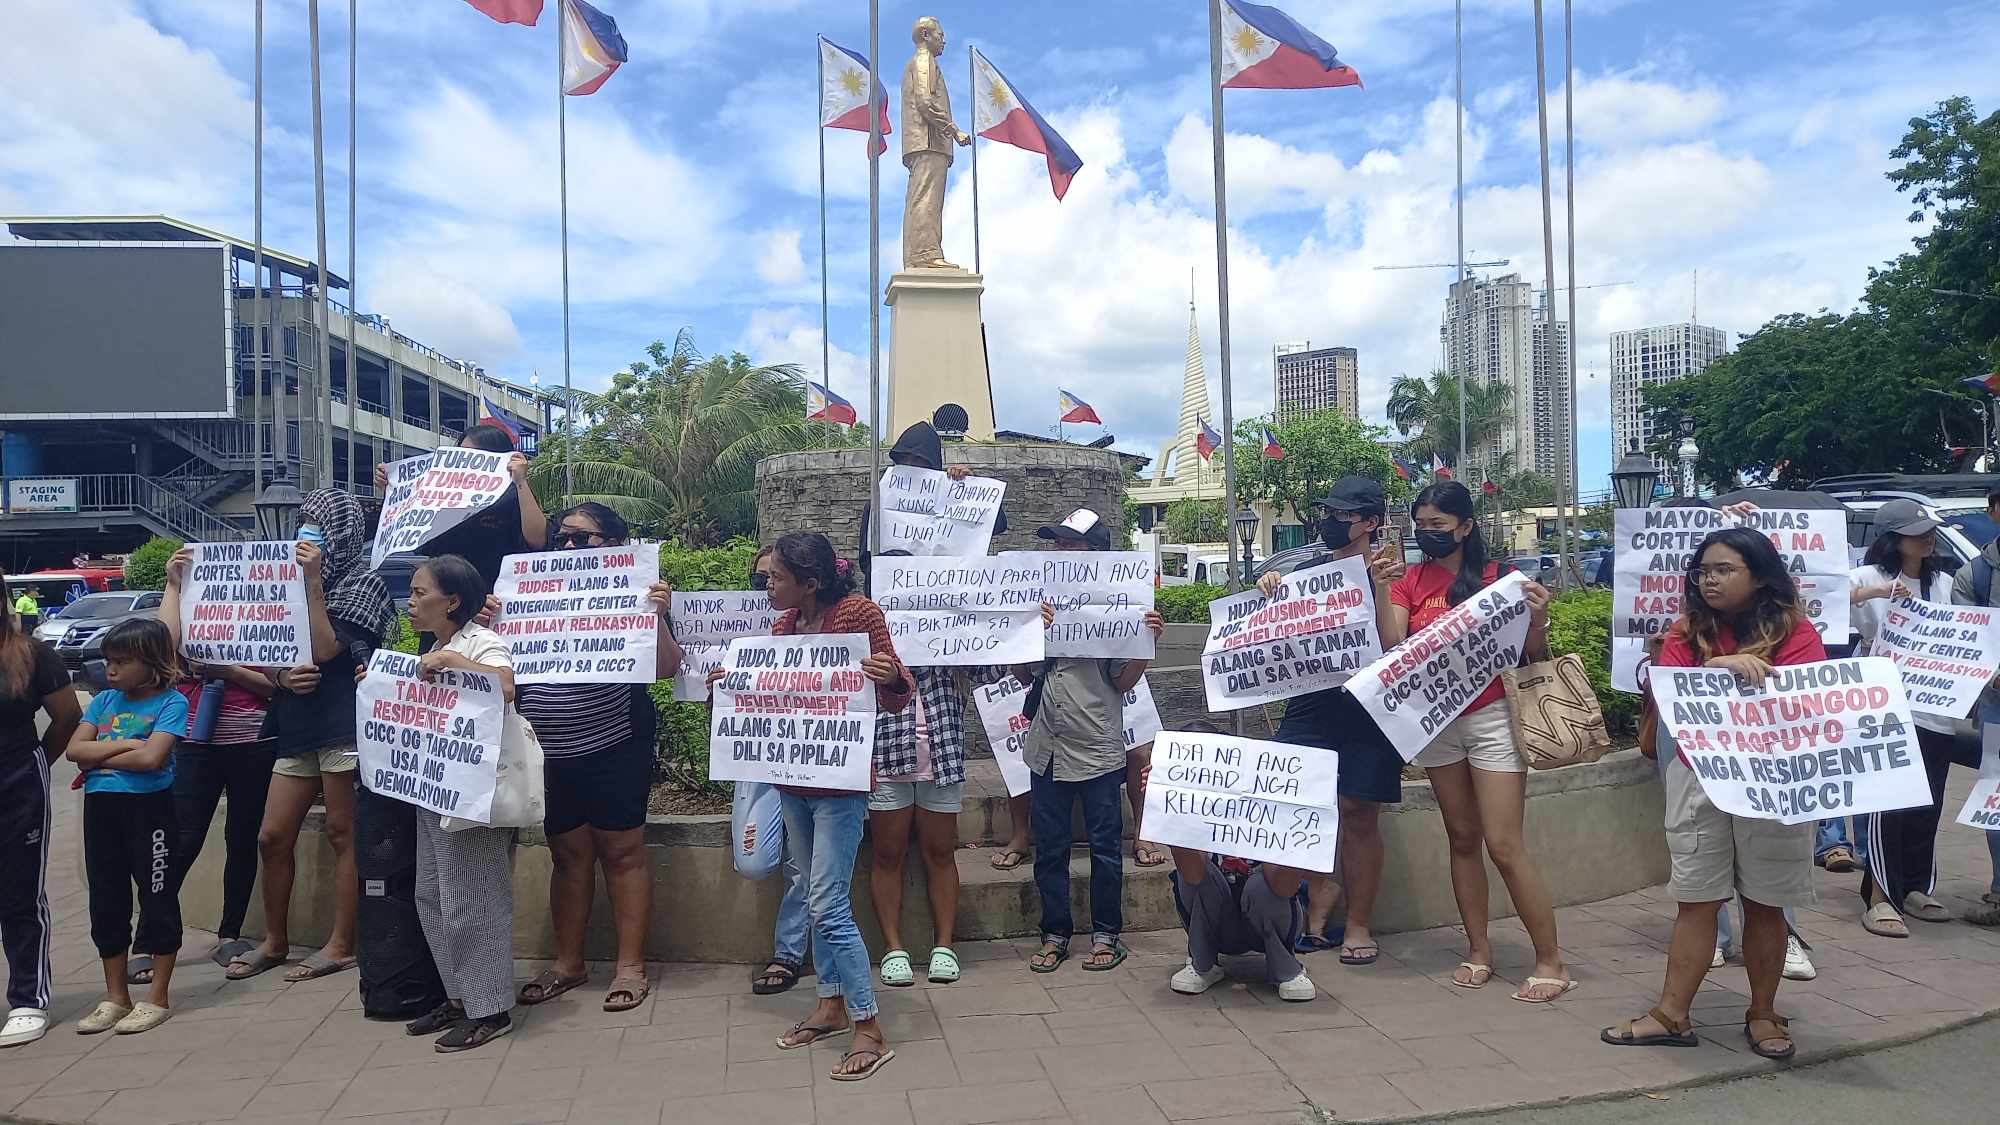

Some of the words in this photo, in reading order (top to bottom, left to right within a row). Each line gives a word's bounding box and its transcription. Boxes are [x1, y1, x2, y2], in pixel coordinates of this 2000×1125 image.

[920, 479, 937, 495] MI
[898, 498, 935, 513] KUNG
[1645, 510, 1723, 529] MAYOR
[1631, 531, 1711, 550] CORTE
[1792, 533, 1825, 551] NA
[203, 545, 243, 561] MAYOR
[248, 544, 289, 561] JONAS
[1648, 553, 1693, 572] ANG
[194, 565, 244, 583] CORTES,
[249, 565, 274, 581] ASA
[280, 564, 297, 581] NA
[514, 561, 529, 575] 3B
[532, 560, 547, 573] UG
[551, 556, 599, 572] DUGANG
[603, 554, 635, 568] 500M
[1110, 560, 1149, 583] ANG
[517, 579, 563, 594] BUDGET
[568, 576, 609, 592] ALANG
[613, 575, 629, 589] SA
[893, 569, 995, 590] RELOCATION
[1001, 569, 1040, 585] PARA
[1296, 571, 1344, 597] YOUR
[201, 585, 228, 601] ANG
[232, 585, 265, 601] LUNA
[270, 585, 287, 601] SA
[879, 596, 899, 615] SA
[906, 592, 968, 611] SHARER
[976, 590, 995, 606] UG
[1106, 593, 1128, 614] SA
[194, 605, 234, 621] IMONG
[507, 597, 584, 615] GOVERNMENT
[588, 595, 638, 610] CENTER
[684, 599, 725, 616] MAYOR
[1248, 598, 1317, 629] HOUSING
[1326, 588, 1363, 612] AND
[1901, 597, 1955, 622] DUGANG
[1956, 612, 1990, 626] 500M
[188, 624, 235, 640] KASING
[239, 625, 295, 642] NAMONG
[525, 619, 565, 634] WALAY
[570, 616, 655, 632] RELOKASYON
[710, 618, 753, 633] NAMAN
[759, 617, 776, 630] AN
[918, 614, 977, 633] BIKTIMA
[989, 617, 1010, 630] SA
[1911, 624, 1956, 639] ALANG
[1959, 630, 1978, 643] SA
[512, 640, 548, 656] ALANG
[552, 639, 569, 653] SA
[574, 638, 626, 652] TANANG
[928, 635, 1000, 658] SUNOG
[1377, 609, 1479, 689] RESIDENTE
[1479, 591, 1509, 617] SA
[185, 644, 214, 660] MGA
[217, 644, 254, 661] TAGA
[259, 645, 299, 662] CICC?
[737, 648, 778, 670] HUDO,
[783, 648, 801, 668] DO
[810, 647, 850, 668] YOUR
[1210, 649, 1266, 676] ALANG
[1271, 643, 1295, 662] SA
[1300, 628, 1370, 657] TANAN,
[1384, 673, 1422, 712] CICC
[1427, 652, 1450, 677] OG
[1452, 600, 1526, 657] TARONG
[1929, 644, 1983, 661] CENTER
[575, 660, 591, 673] SA
[596, 658, 636, 673] CICC?
[1422, 669, 1462, 704] USA
[1465, 638, 1498, 674] ANG
[1904, 657, 1992, 679] RELOKASYON
[462, 672, 492, 693] ANG
[719, 672, 752, 691] JOB:
[756, 671, 823, 692] HOUSING
[830, 671, 864, 692] AND
[1227, 672, 1261, 693] DILI
[1265, 665, 1292, 683] SA
[1902, 672, 1954, 690] TANANG
[396, 680, 459, 710] TANANG
[1420, 645, 1518, 736] DEMOLISYON
[1916, 692, 1956, 708] CICC?
[735, 694, 848, 716] DEVELOPMENT
[1674, 702, 1722, 725] ANG
[1729, 687, 1888, 726] KATUNGOD
[373, 700, 449, 734] RESIDENTE
[452, 716, 475, 740] SA
[717, 717, 771, 738] ALANG
[777, 718, 796, 739] SA
[803, 720, 864, 744] TANAN,
[365, 721, 396, 745] CICC
[401, 728, 421, 749] OG
[426, 734, 484, 765] TARONG
[1677, 730, 1715, 752] SA
[1718, 720, 1844, 753] PAGPUYO
[1858, 713, 1906, 739] SA
[733, 741, 762, 762] DILI
[767, 743, 785, 763] SA
[1169, 741, 1203, 762] ASA
[1215, 748, 1241, 766] NA
[1257, 751, 1303, 774] ANG
[1691, 755, 1745, 782] MGA
[1749, 740, 1911, 785] RESIDENTE
[391, 749, 419, 774] USA
[422, 759, 445, 783] ANG
[1168, 765, 1240, 789] GISAAD
[1252, 774, 1299, 797] NGA
[1746, 787, 1777, 815] SA
[1779, 781, 1854, 817] CICC!
[1165, 790, 1277, 825] RELOCATION
[1290, 808, 1320, 830] SA
[1970, 810, 2000, 825] MG
[152, 829, 169, 893] adidas
